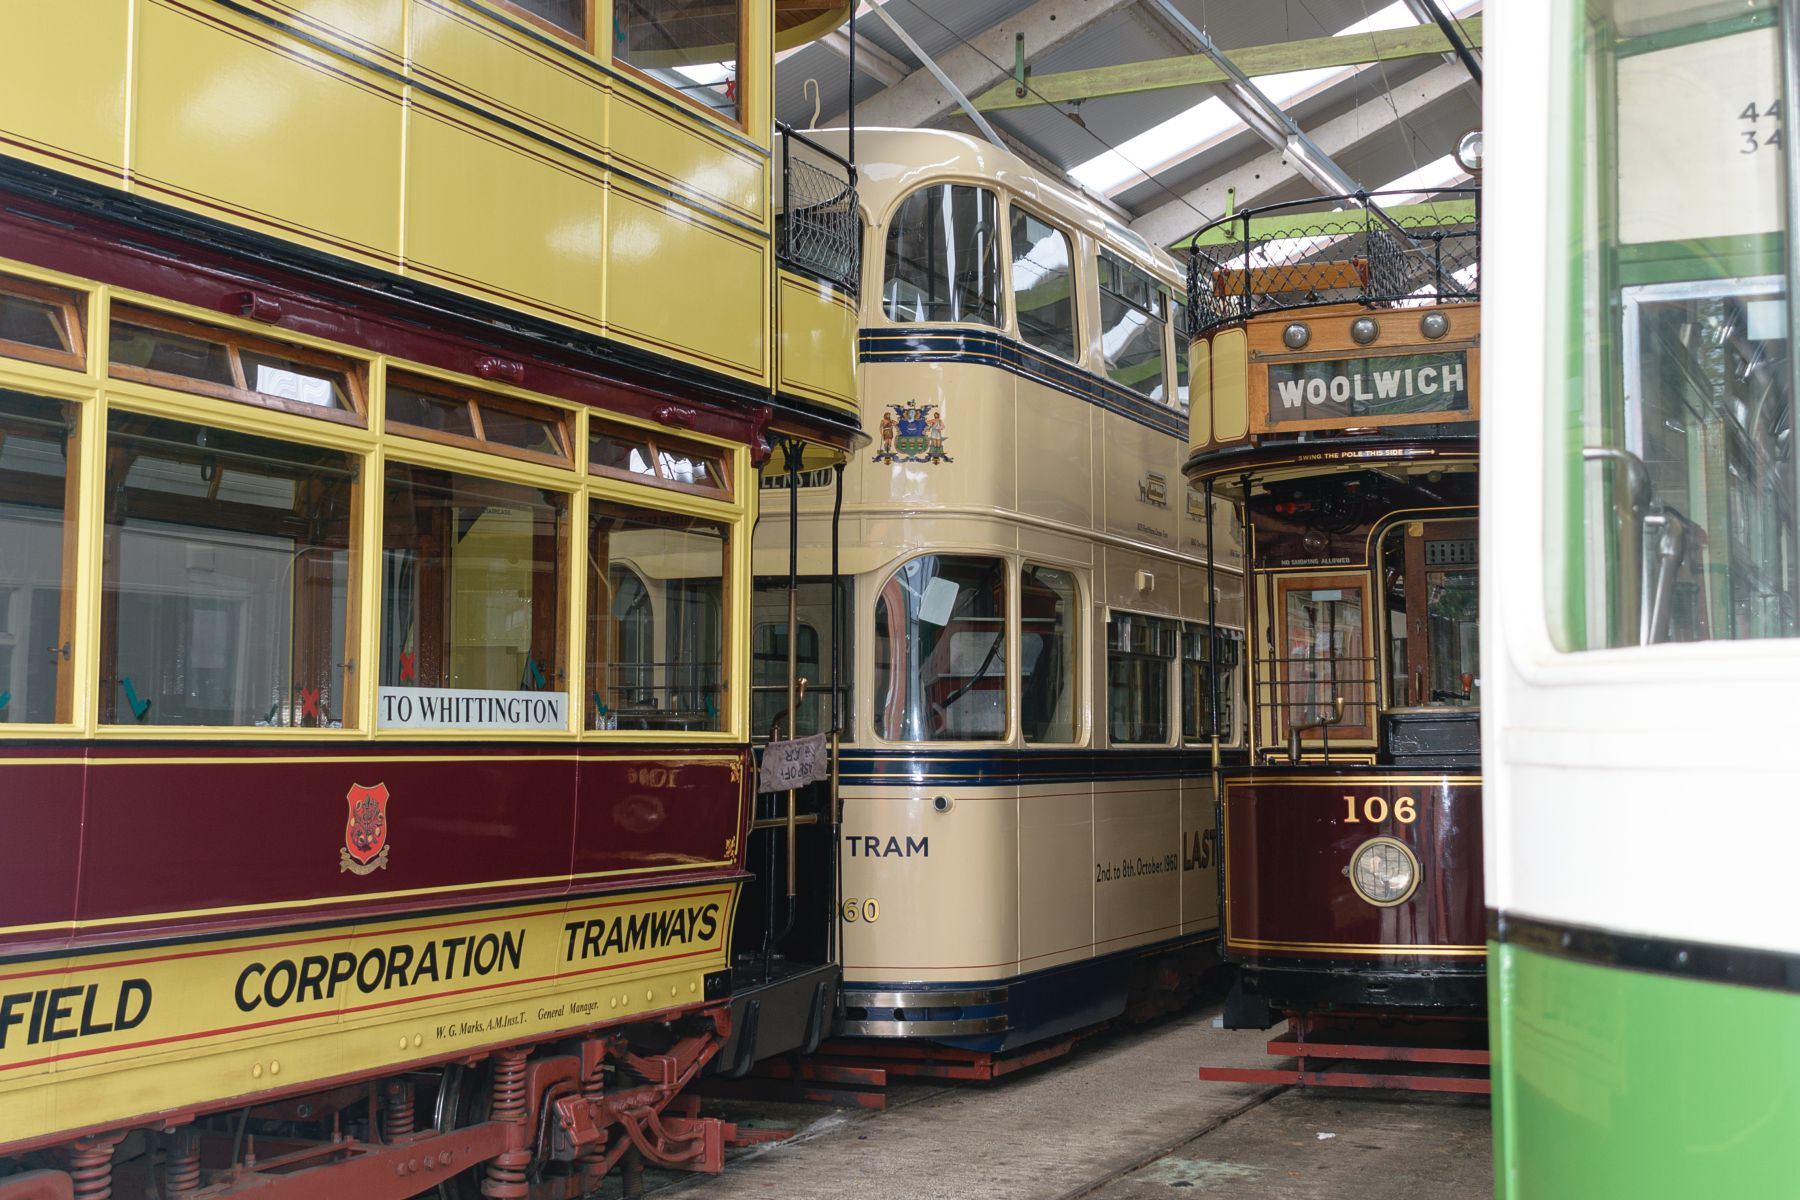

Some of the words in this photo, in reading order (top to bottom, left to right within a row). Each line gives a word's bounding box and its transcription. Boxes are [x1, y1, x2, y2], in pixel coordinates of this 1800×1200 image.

[1738, 99, 1782, 123] 44
[1740, 128, 1782, 154] 34
[1278, 364, 1464, 408] WOOLWICH
[1321, 557, 1350, 565] ALLOWED
[383, 695, 413, 722] TO
[418, 696, 559, 724] WHITTINGTON
[1343, 796, 1417, 824] 106
[845, 836, 929, 858] TRAM
[1183, 828, 1217, 871] LAST
[1096, 862, 1113, 882] 2nd.
[1113, 866, 1121, 880] to
[1122, 859, 1136, 877] 8th.
[835, 897, 881, 923] 60
[0, 978, 153, 1049] FIELD
[234, 929, 526, 1012] CORPORATION
[565, 903, 720, 962] TRAMWAYS
[436, 1026, 446, 1039] W.
[448, 1024, 457, 1037] G.
[458, 1021, 485, 1035] Marks,
[537, 1005, 565, 1020] General
[568, 1001, 599, 1015] Manager.
